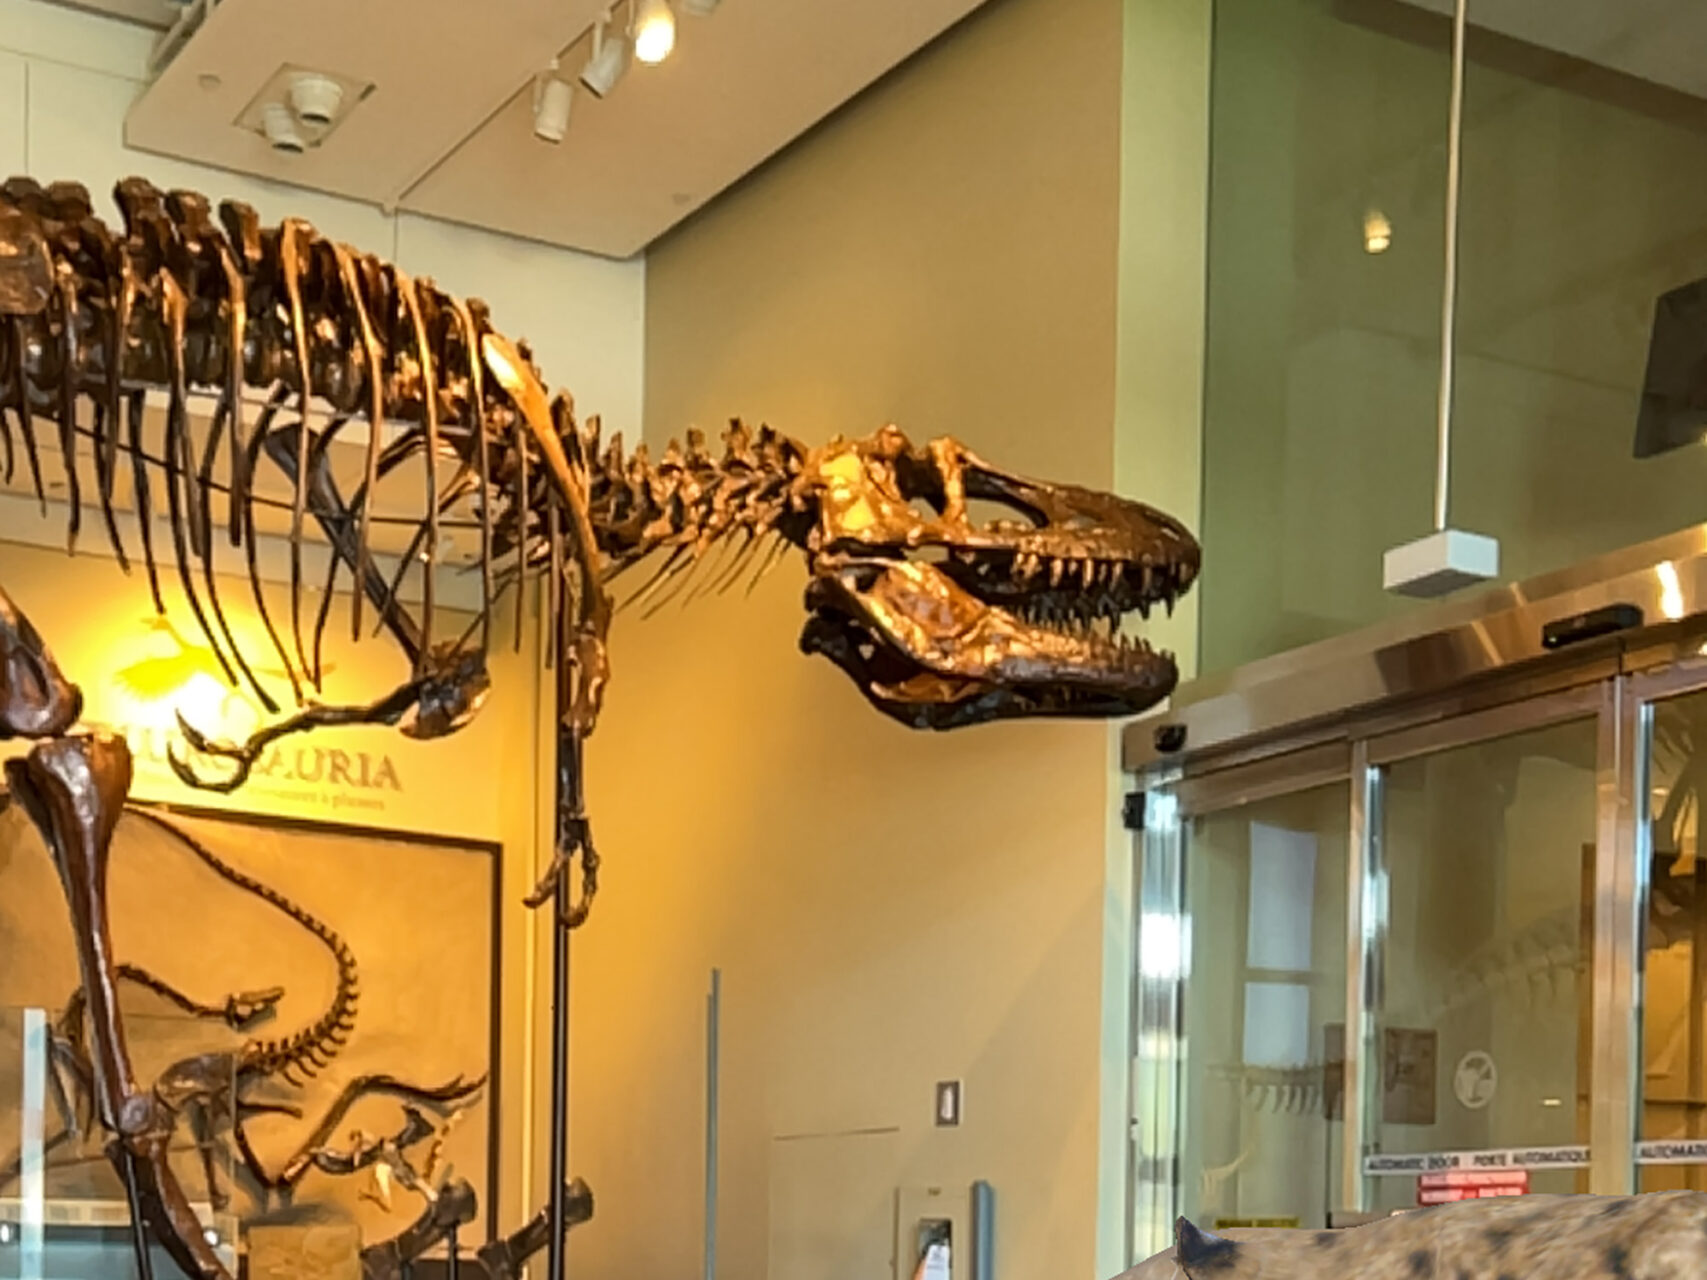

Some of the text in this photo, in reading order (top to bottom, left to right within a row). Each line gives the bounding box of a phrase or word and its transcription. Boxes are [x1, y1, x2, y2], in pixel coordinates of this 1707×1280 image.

[138, 727, 402, 792] INOAURIA
[1641, 1142, 1707, 1159] AUTOMATI
[1368, 1156, 1424, 1171] AUTOMATIC
[1427, 1153, 1460, 1168] DOOR
[1474, 1151, 1506, 1166] PORTE
